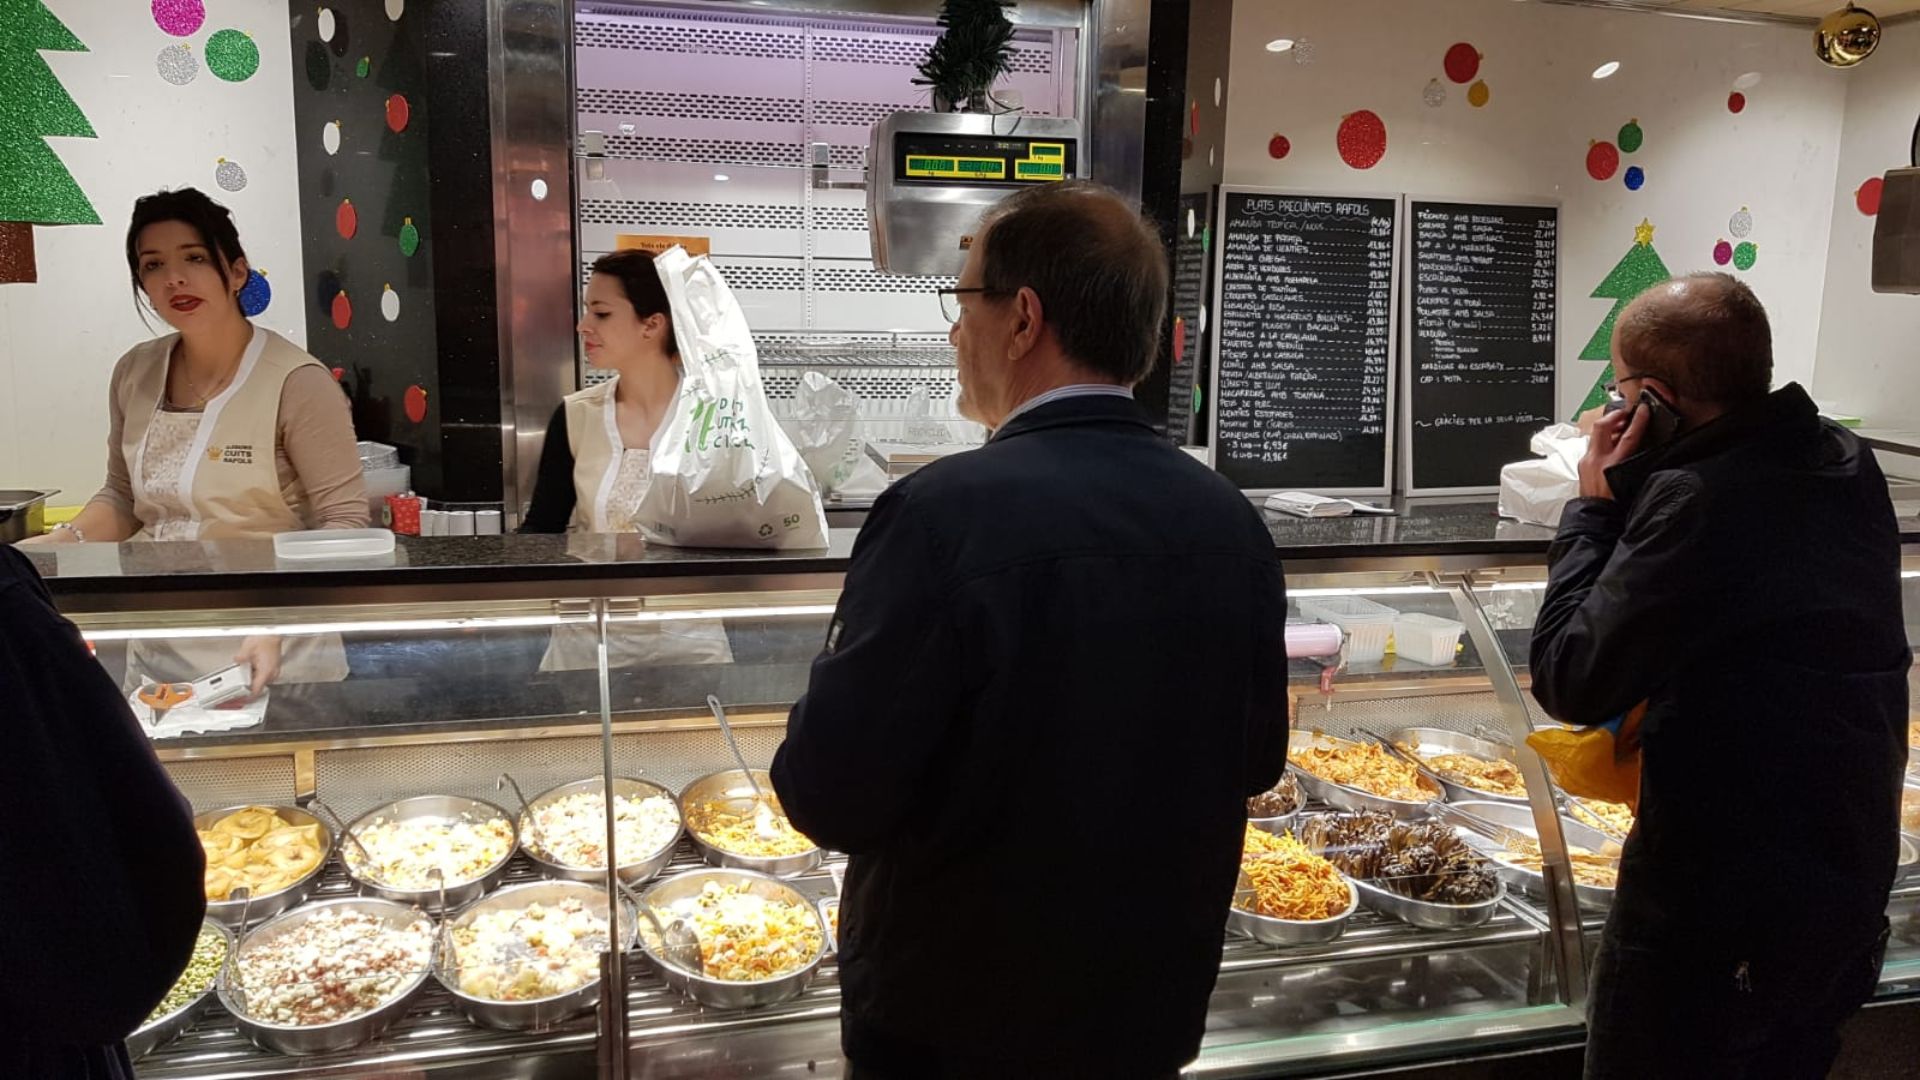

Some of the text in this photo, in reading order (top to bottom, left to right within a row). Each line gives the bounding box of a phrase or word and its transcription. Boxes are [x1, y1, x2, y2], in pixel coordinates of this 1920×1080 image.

[1247, 199, 1369, 216] PLATS PRECUINATS RAFOLS
[1454, 215, 1469, 223] AMB
[1455, 309, 1469, 317] AMB
[1269, 332, 1277, 340] LA
[1258, 341, 1272, 349] AMB
[1272, 362, 1294, 370] SALSA
[1271, 391, 1287, 399] AMB
[224, 450, 252, 458] CUITS
[783, 513, 801, 528] 50
